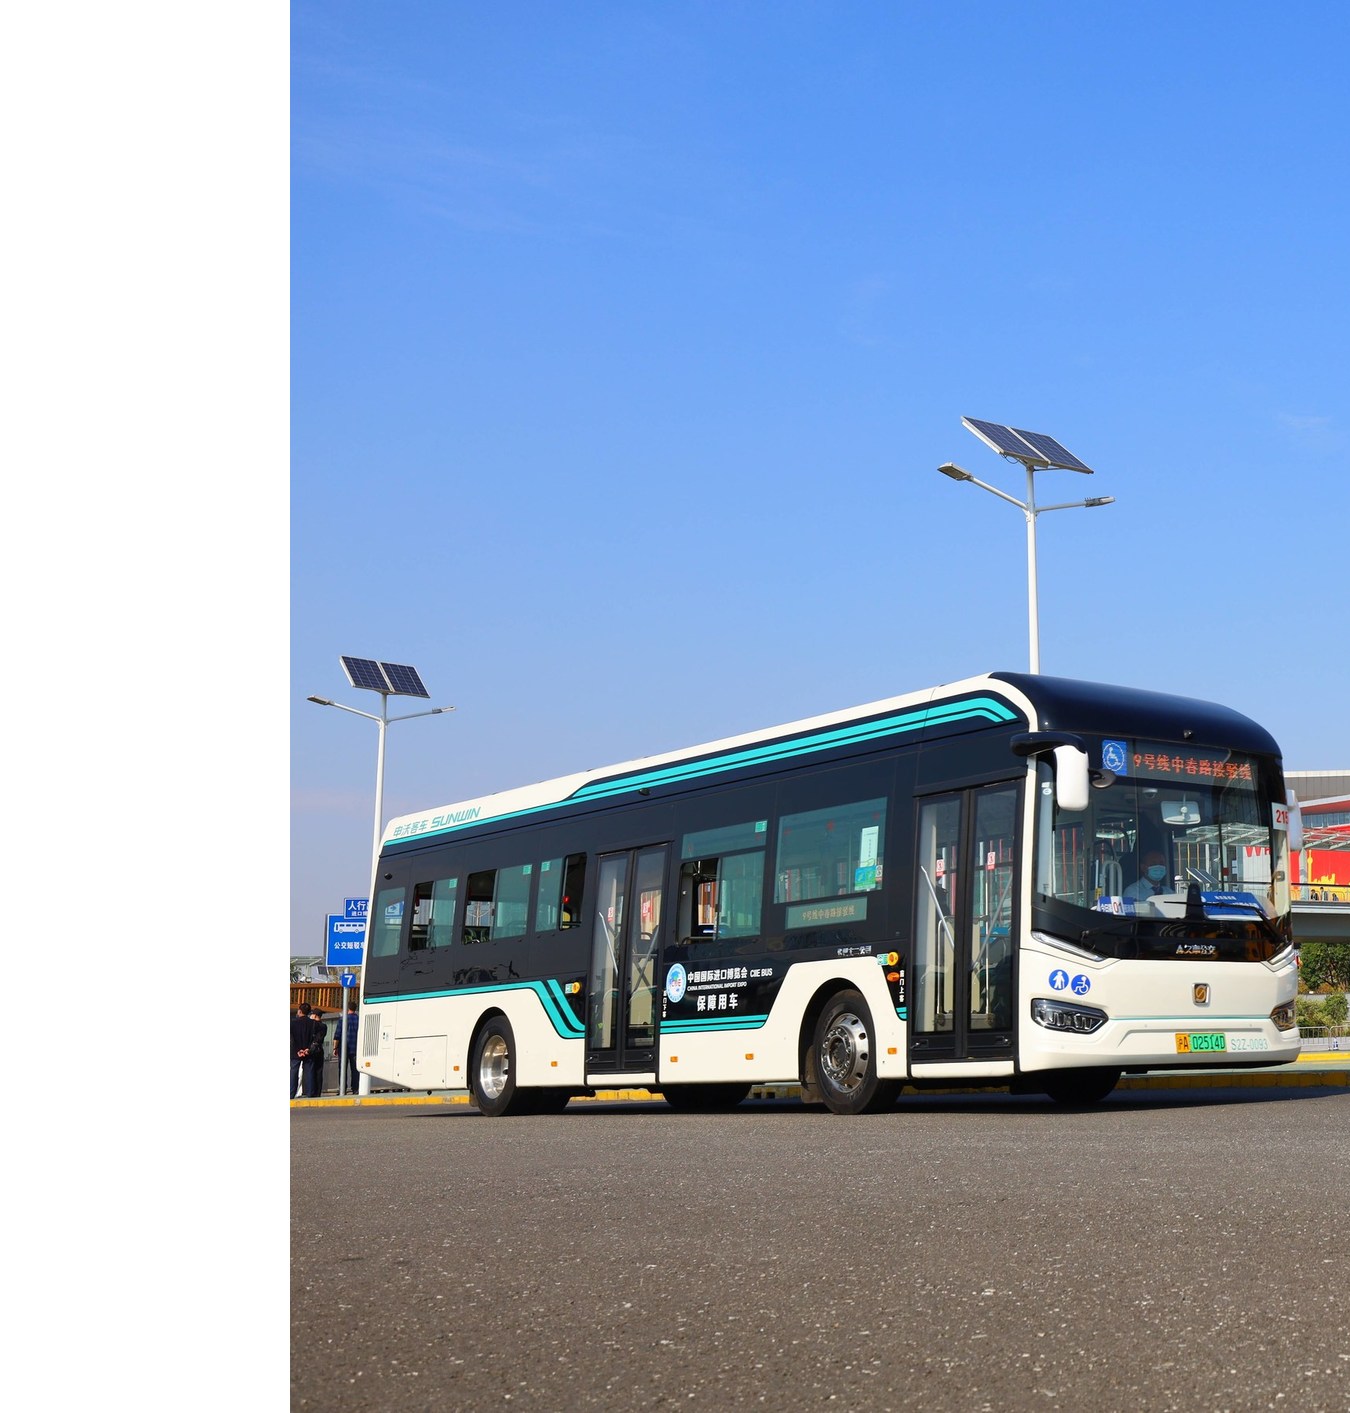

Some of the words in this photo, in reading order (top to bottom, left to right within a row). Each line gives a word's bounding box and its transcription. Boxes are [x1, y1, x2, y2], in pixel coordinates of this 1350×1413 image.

[431, 806, 481, 828] SUNWIN
[344, 975, 353, 985] 7
[687, 966, 747, 983] 中国国际进口博览会
[761, 968, 773, 977] BUS
[697, 993, 739, 1011] 保障用车
